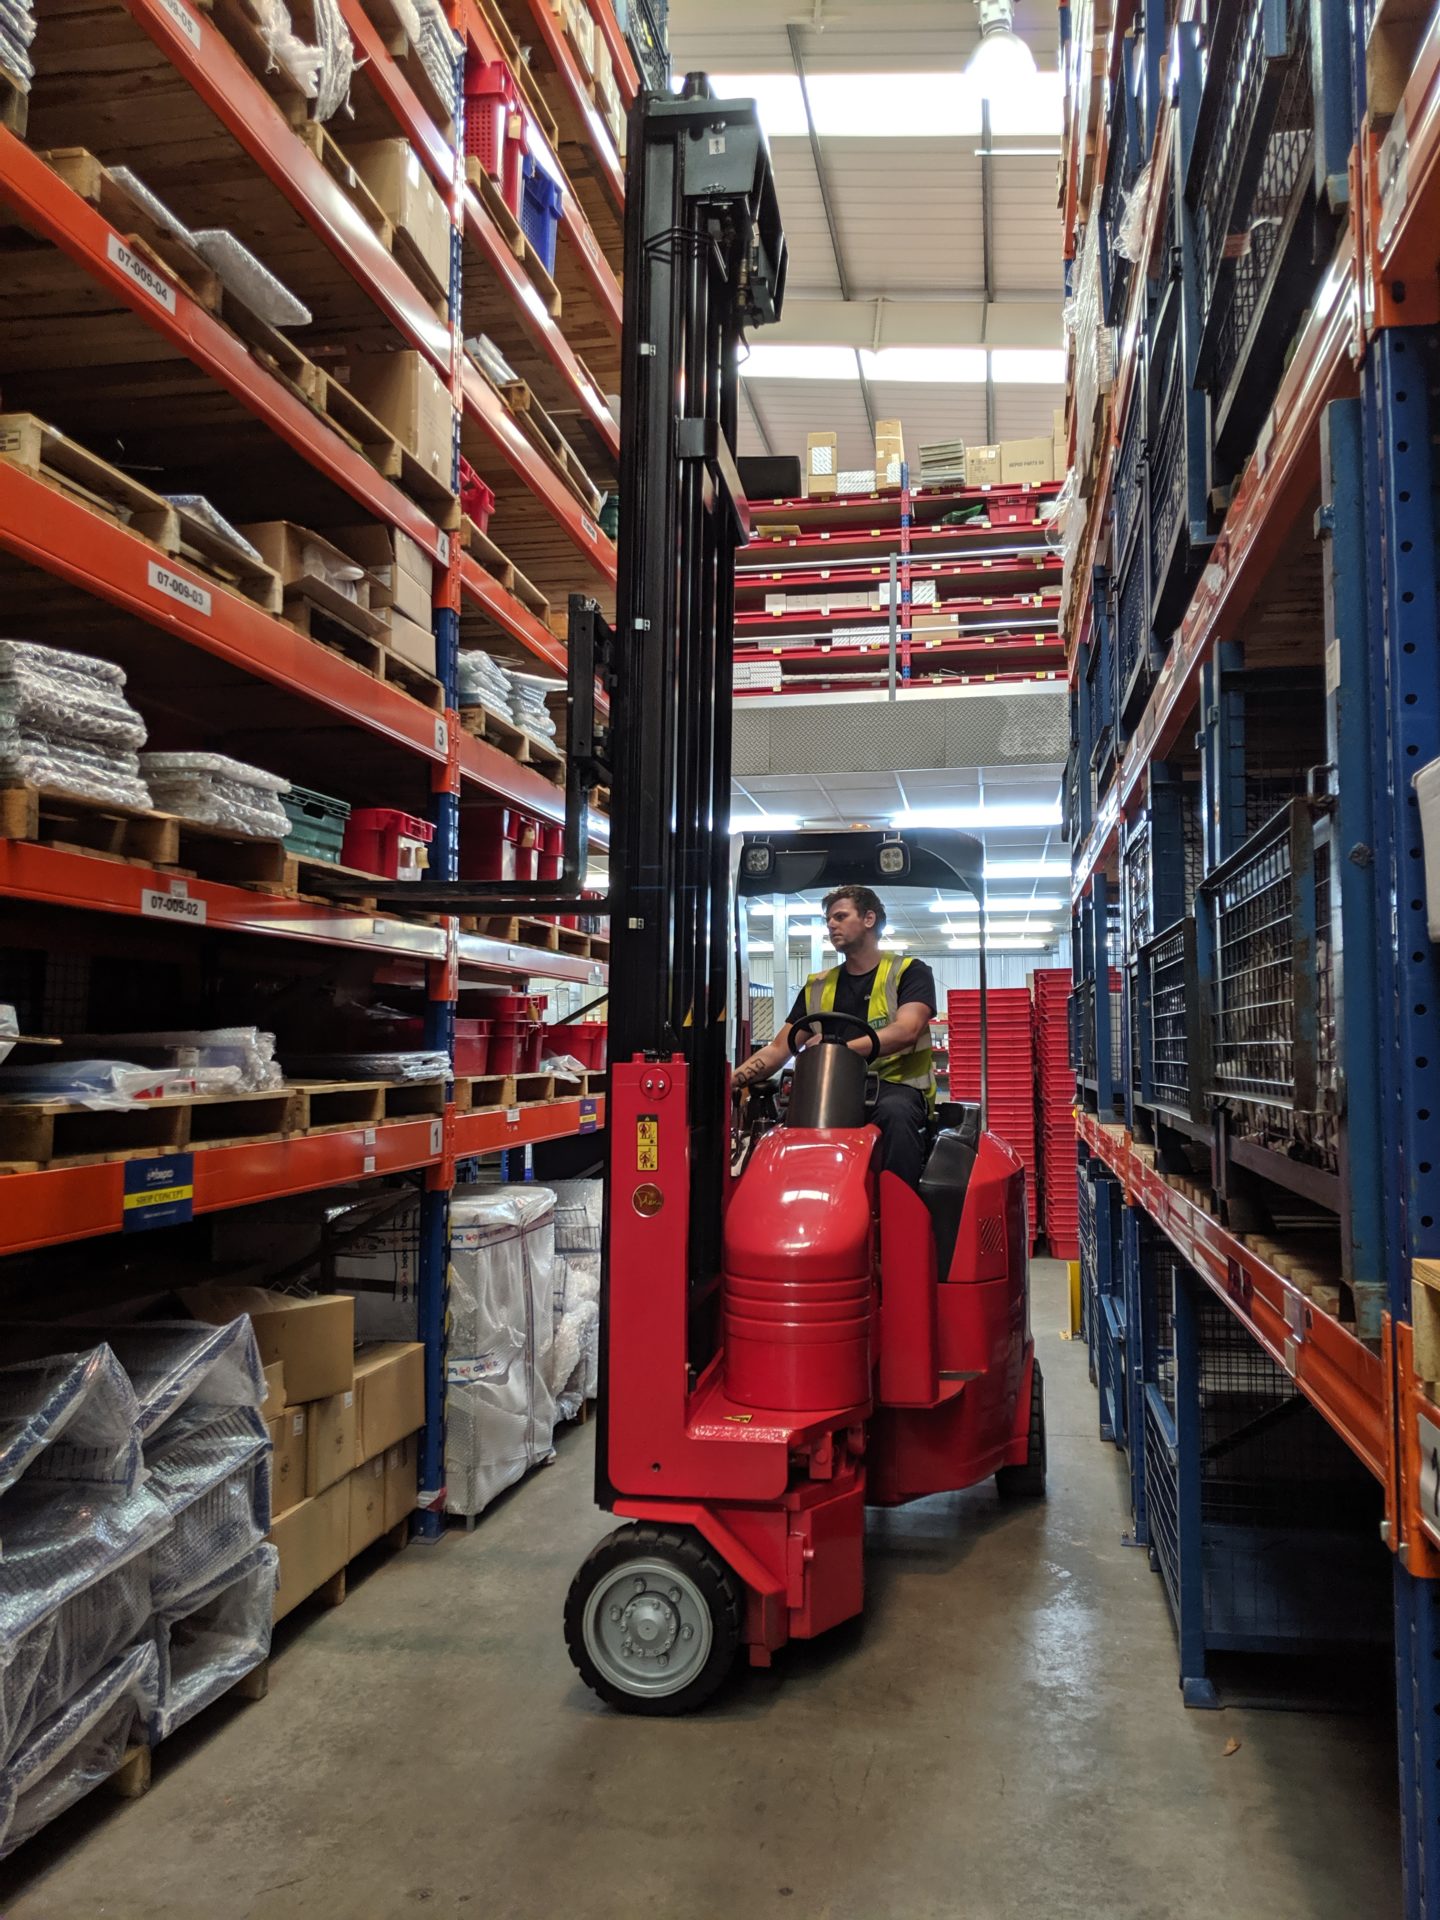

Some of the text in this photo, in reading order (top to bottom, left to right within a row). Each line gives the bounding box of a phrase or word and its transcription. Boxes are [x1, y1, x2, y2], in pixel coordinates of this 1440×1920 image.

[118, 247, 167, 301] 07-009-04
[157, 571, 204, 606] 07-009-03
[438, 725, 444, 746] 3
[434, 1127, 439, 1148] 1
